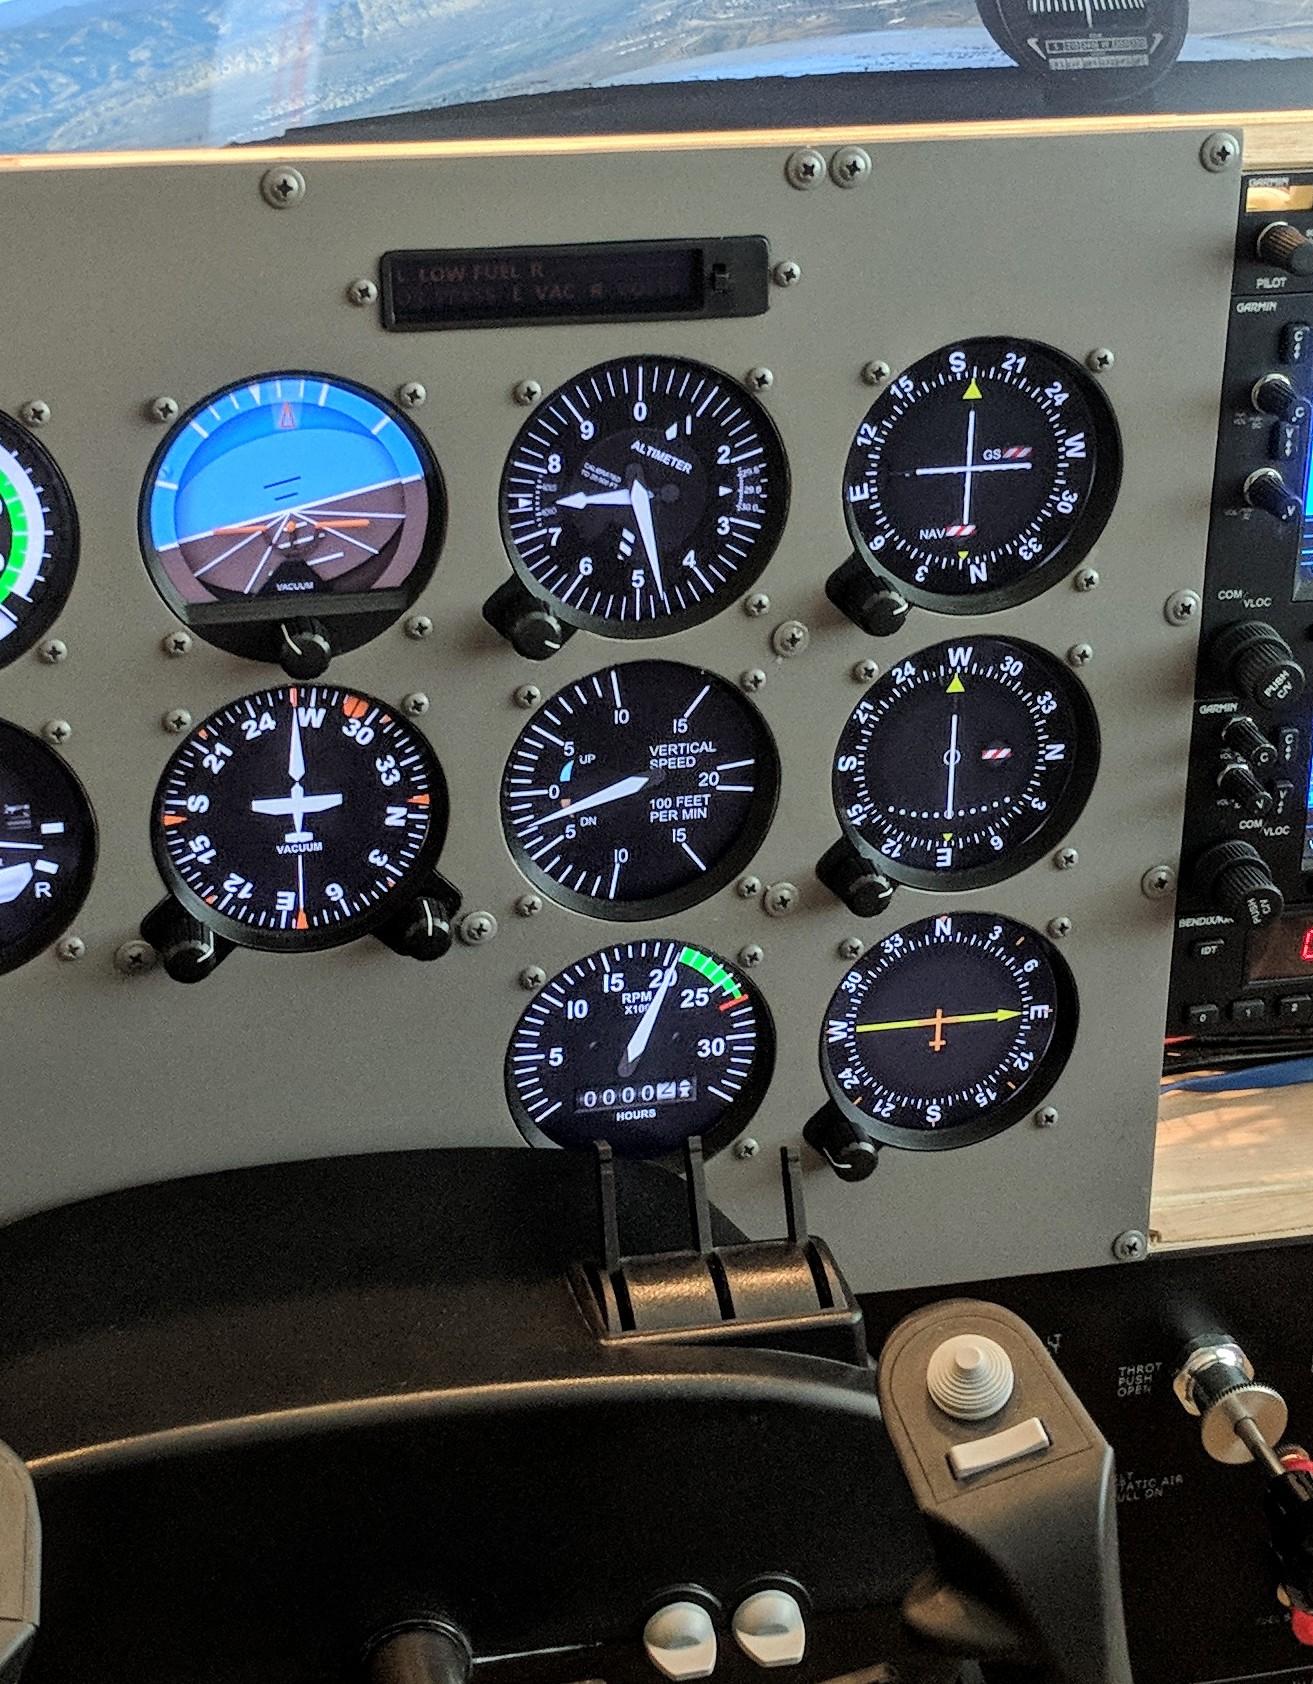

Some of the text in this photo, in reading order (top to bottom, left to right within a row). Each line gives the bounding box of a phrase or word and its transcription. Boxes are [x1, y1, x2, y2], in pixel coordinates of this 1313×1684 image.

[1256, 277, 1288, 289] PILOT
[1236, 301, 1277, 313] GARMIN
[949, 351, 966, 374] S
[1001, 352, 1027, 374] 21
[633, 401, 647, 422] 0
[631, 440, 693, 475] ALTIMETER
[717, 445, 731, 465] 2
[983, 448, 1002, 461] GS
[920, 529, 945, 540] NAV
[276, 581, 314, 592] VACUUM
[631, 569, 645, 588] 5
[948, 646, 974, 668] W
[1263, 669, 1291, 698] PUSH
[298, 707, 326, 729] W
[673, 718, 689, 734] 15
[342, 718, 374, 746] 30
[649, 740, 717, 757] VERTICAL
[579, 753, 597, 765] UP
[649, 755, 697, 769] SPEED
[698, 771, 720, 788] 20
[649, 793, 711, 810] 100 FEET
[579, 815, 597, 828] DN
[650, 807, 708, 823] PER MIN
[1239, 819, 1290, 837] COM VLOC
[276, 841, 323, 855] VACUUM
[35, 881, 52, 898] R
[934, 917, 952, 937] N
[603, 973, 624, 994] 15
[621, 991, 653, 1005] RPM
[680, 987, 710, 1009] 25
[566, 999, 588, 1020] 10
[1029, 1003, 1049, 1020] E
[616, 1109, 656, 1122] HOURS
[1118, 1362, 1163, 1377] THROT
[1118, 1374, 1153, 1386] PUSH
[1117, 1384, 1151, 1398] OPEN
